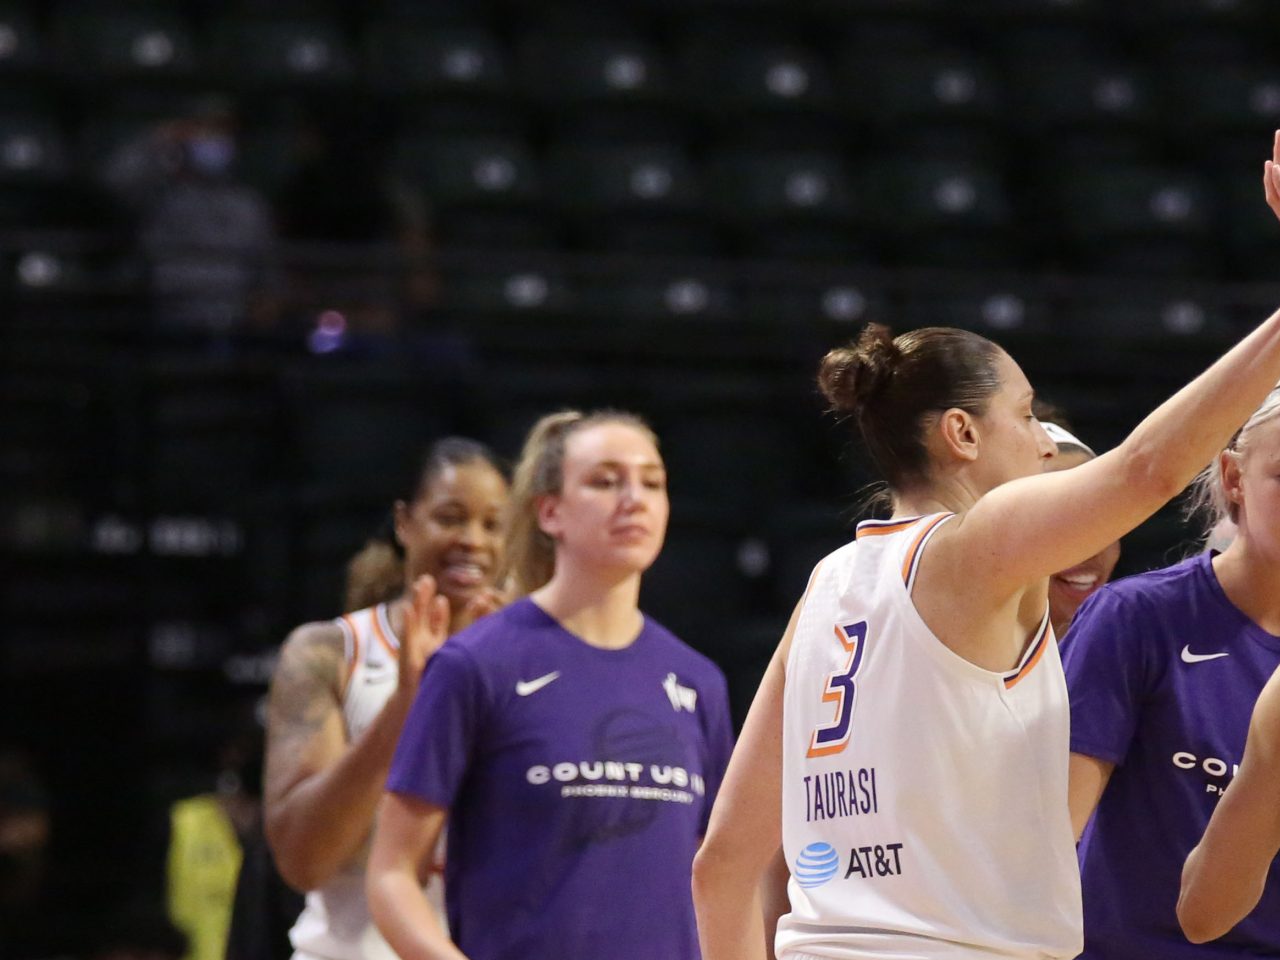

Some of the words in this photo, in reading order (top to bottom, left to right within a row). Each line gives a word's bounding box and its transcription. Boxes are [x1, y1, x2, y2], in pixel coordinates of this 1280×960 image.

[806, 619, 868, 758] 3
[526, 761, 643, 785] COUNT
[650, 764, 688, 787] US
[803, 767, 878, 822] TAURASI
[844, 843, 903, 880] AT&T
